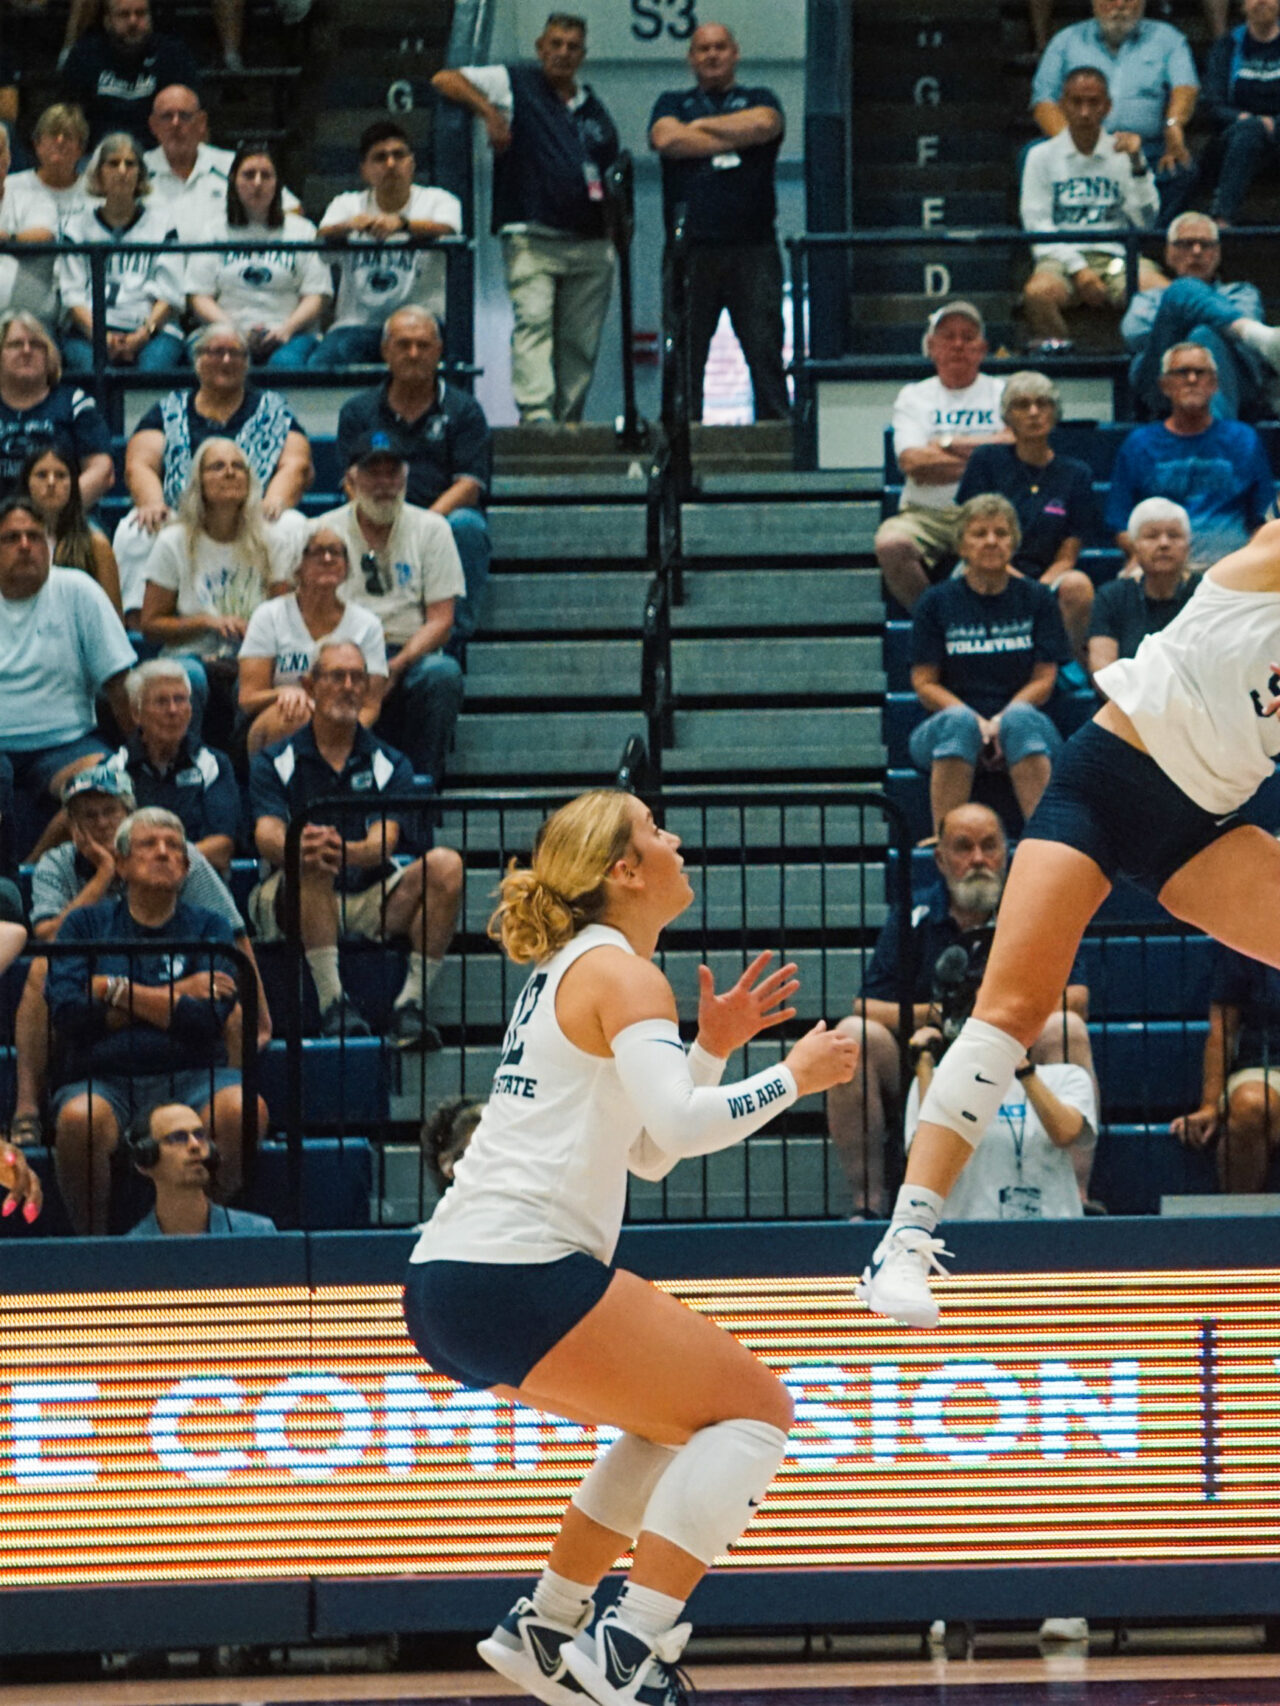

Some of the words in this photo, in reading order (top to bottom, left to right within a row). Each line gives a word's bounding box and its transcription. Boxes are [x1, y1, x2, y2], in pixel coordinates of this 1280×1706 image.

[631, 0, 699, 40] S3
[387, 79, 413, 113] G
[924, 265, 950, 298] D
[727, 1093, 756, 1119] WE
[755, 1078, 786, 1108] ARE
[147, 1359, 1140, 1482] COMPSION
